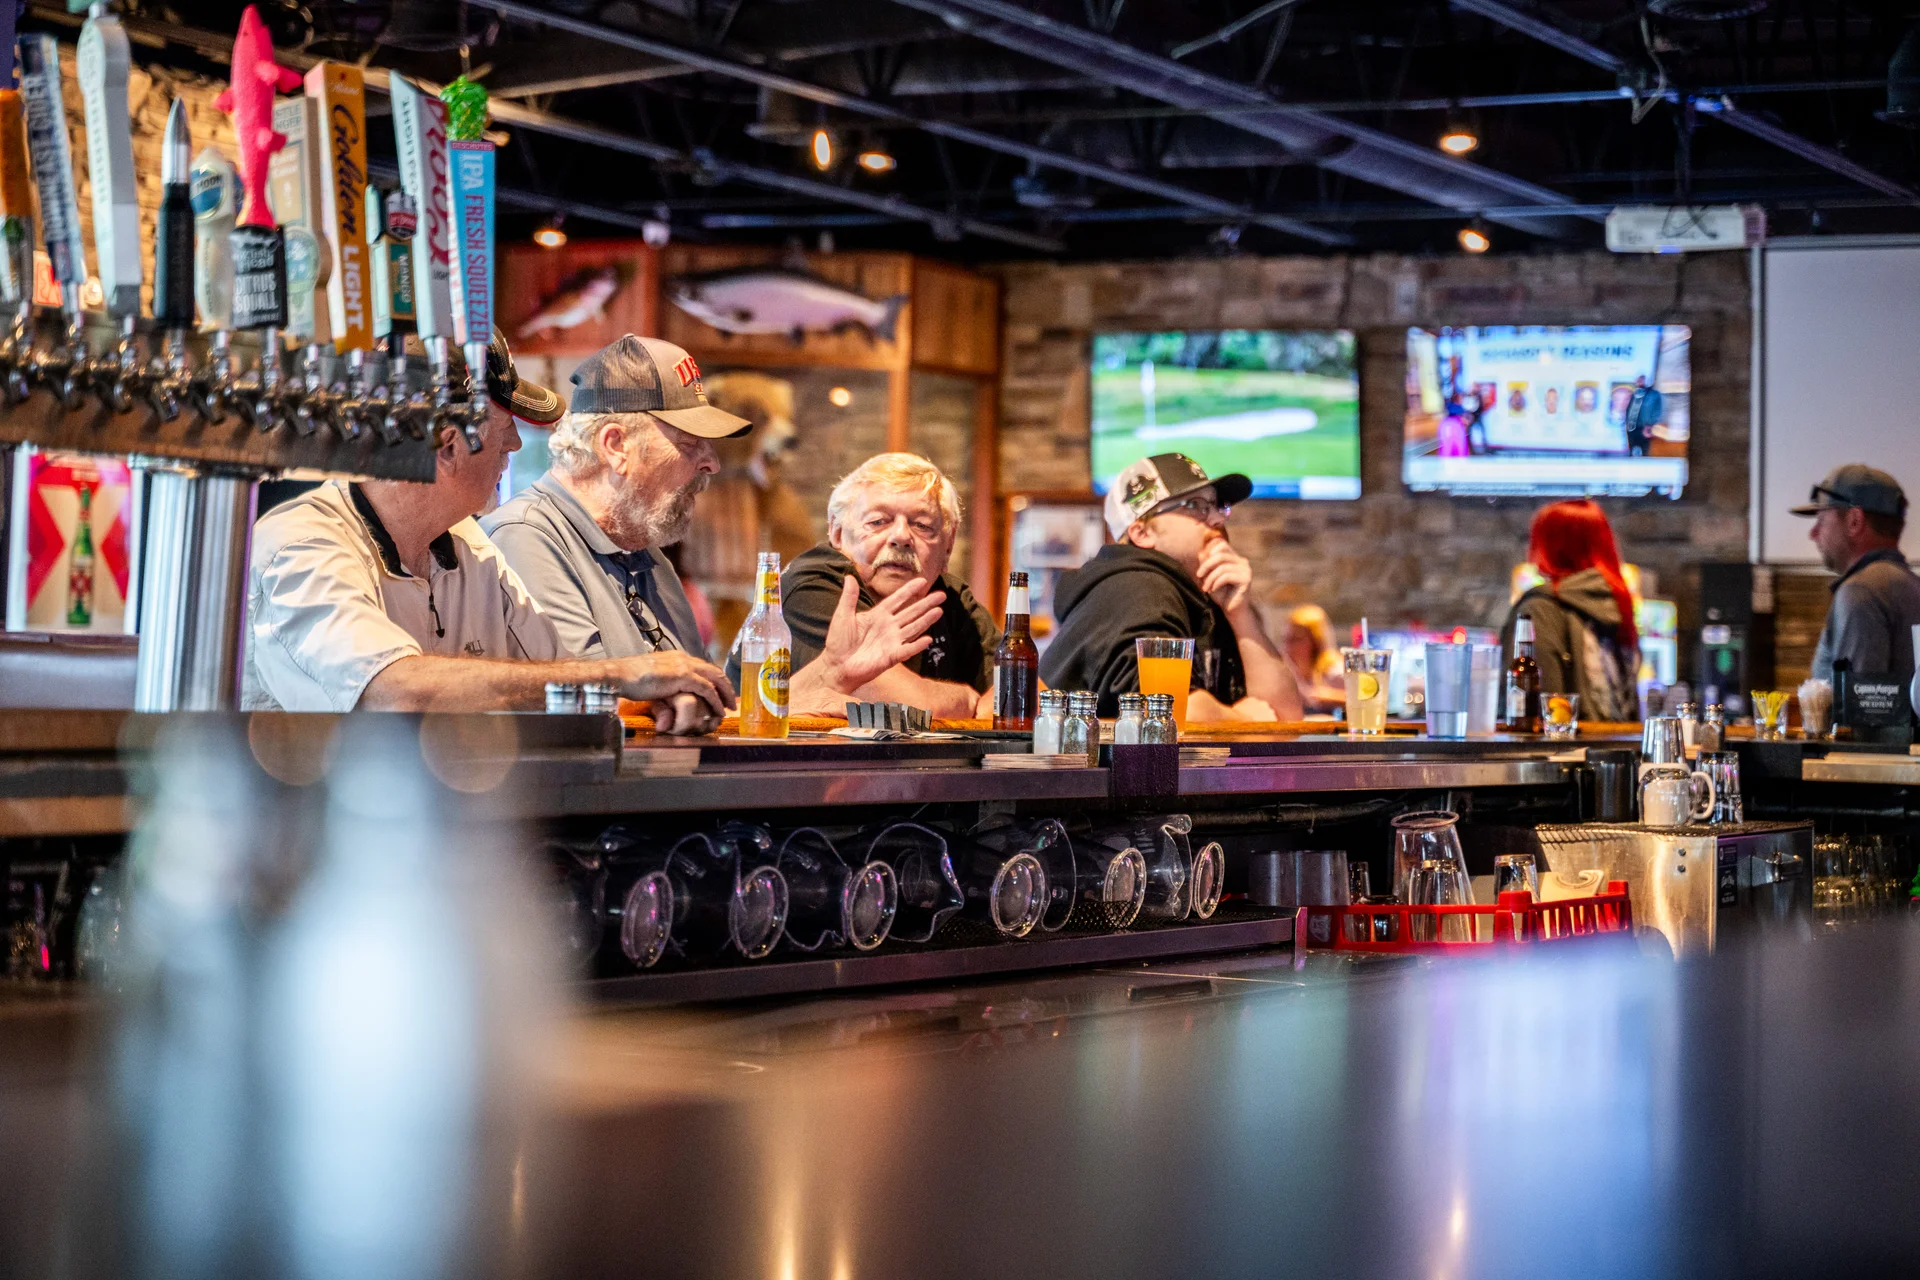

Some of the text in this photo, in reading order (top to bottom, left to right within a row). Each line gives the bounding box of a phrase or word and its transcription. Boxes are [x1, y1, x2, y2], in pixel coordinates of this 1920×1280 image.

[451, 142, 494, 151] DESCHUTES
[333, 104, 362, 241] Golden
[462, 154, 490, 343] IPA FRESH SQUEEZED
[235, 272, 277, 295] CITRUS
[432, 269, 450, 281] LIGH
[342, 244, 364, 332] LIGHT
[235, 291, 280, 315] SQUALL
[1853, 683, 1900, 696] Captain Morgan
